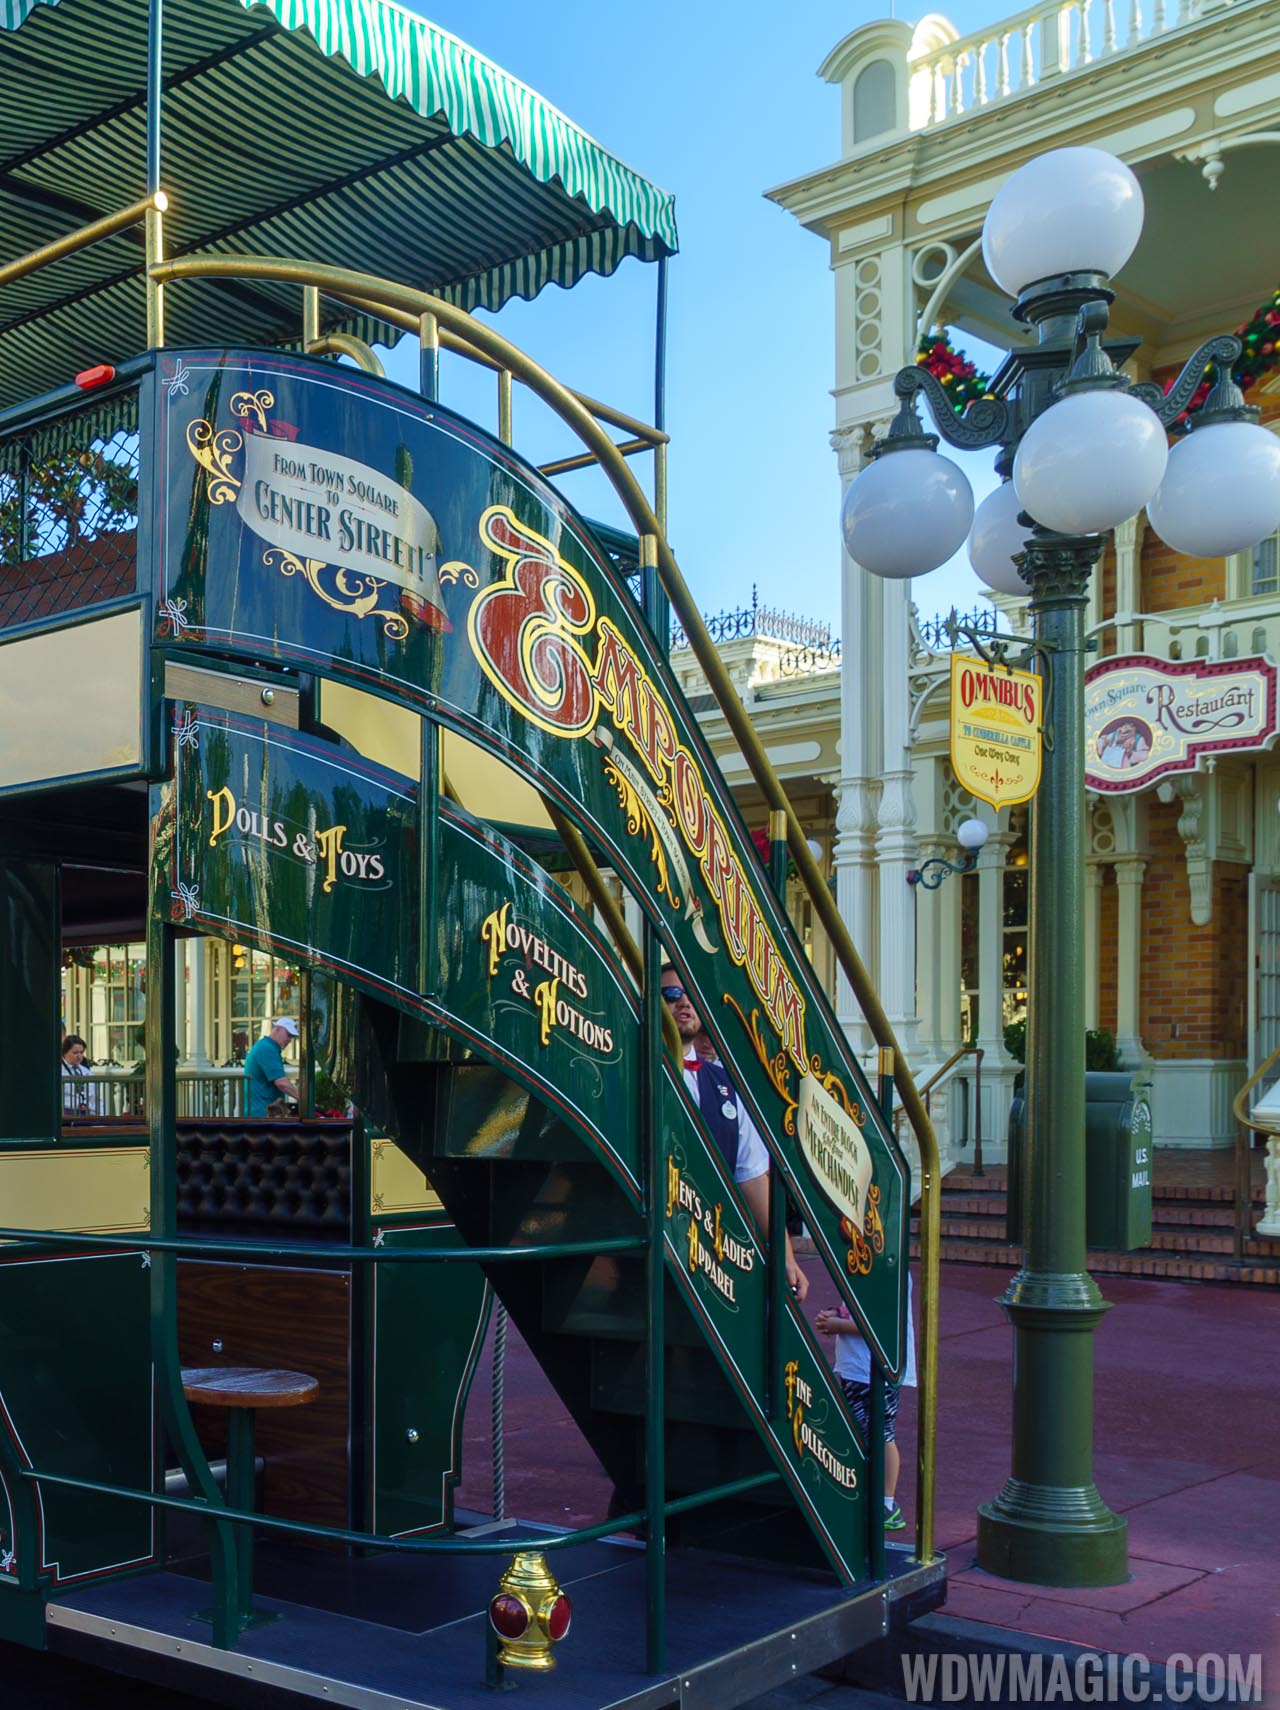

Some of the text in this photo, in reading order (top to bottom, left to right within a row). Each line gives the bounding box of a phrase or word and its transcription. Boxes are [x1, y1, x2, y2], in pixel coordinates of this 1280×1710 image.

[273, 453, 399, 519] FROM TOWN SQUARE
[326, 490, 340, 506] TO
[255, 479, 426, 582] CENTER STREET!
[961, 669, 1035, 723] OMNIBUS
[1107, 684, 1147, 706] Square
[1147, 684, 1254, 734] Restaurant
[467, 505, 809, 1075] EMPORIUM
[207, 786, 385, 893] DOLLS & TOYS
[482, 902, 588, 999] NOVELTIES
[511, 969, 614, 1053] & NOTIONS
[666, 1155, 702, 1220] MEN'S
[704, 1210, 714, 1239] &
[1132, 1170, 1150, 1188] MAIL
[687, 1217, 736, 1302] APPAREL
[785, 1360, 812, 1419] FINE
[793, 1403, 857, 1489] COLLECTIBLES
